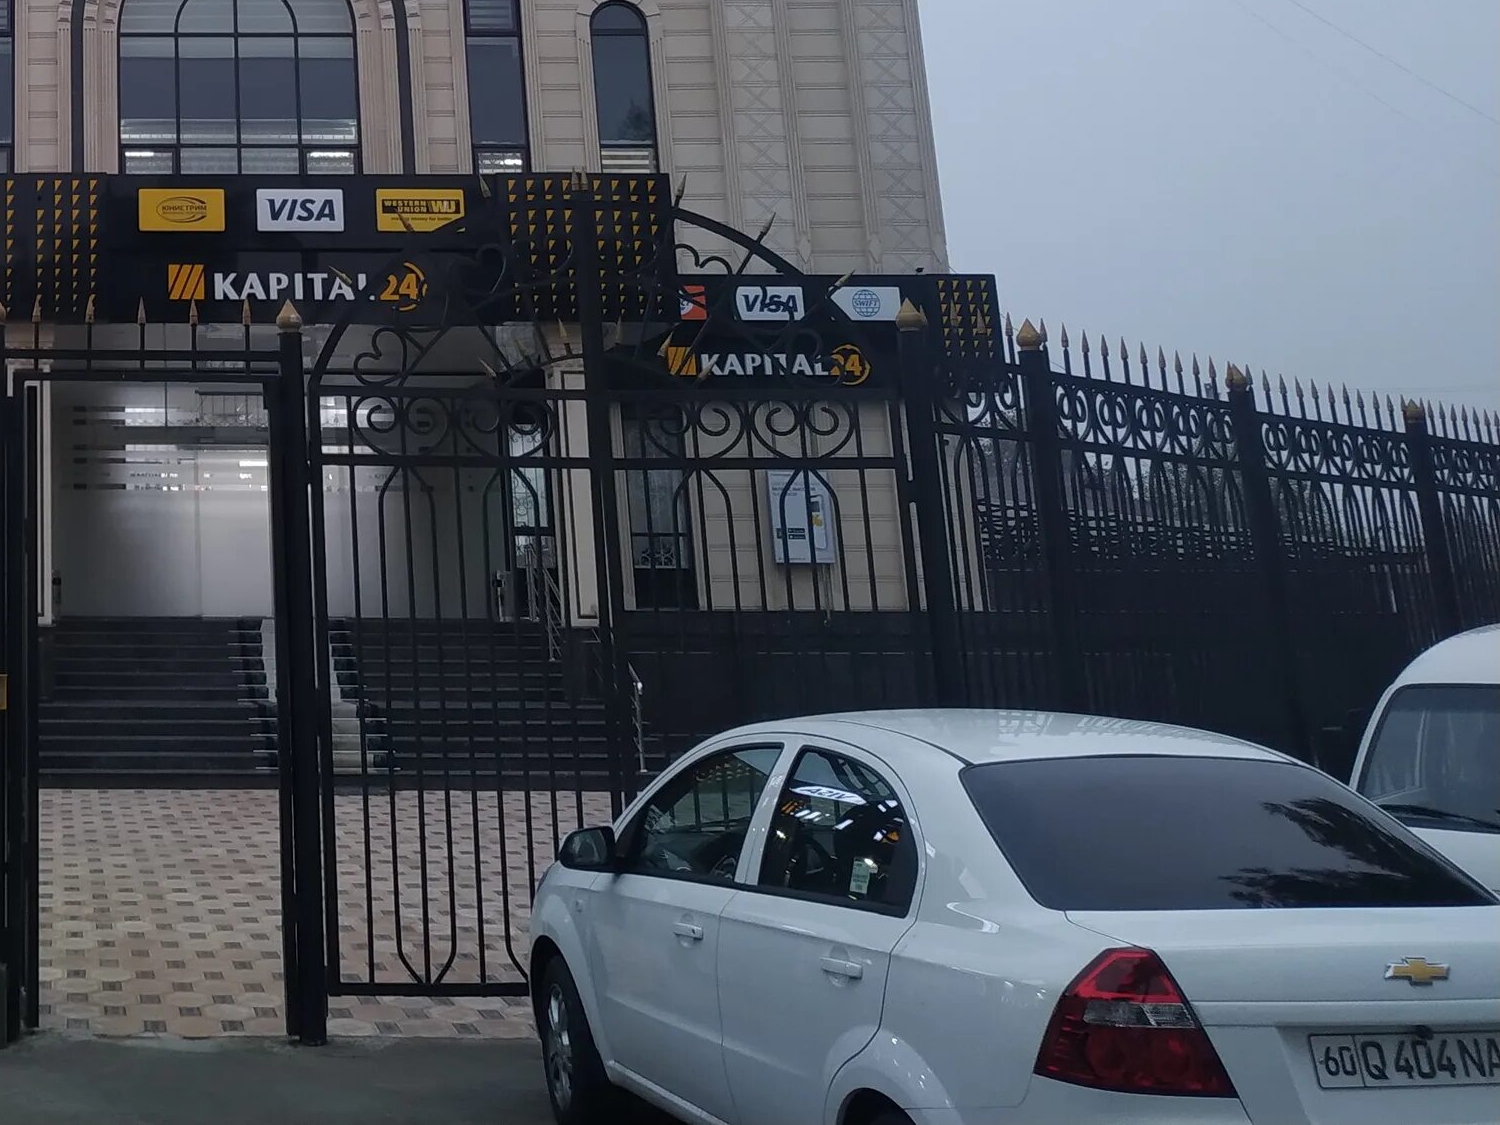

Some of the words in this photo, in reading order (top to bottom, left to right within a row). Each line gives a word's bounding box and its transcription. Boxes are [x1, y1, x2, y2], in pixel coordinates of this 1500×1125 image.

[161, 204, 207, 212] ЮНИСТРИМ
[264, 198, 336, 222] VISA
[741, 294, 798, 313] VISA
[854, 299, 878, 307] SWIFT
[1323, 1046, 1357, 1076] 60
